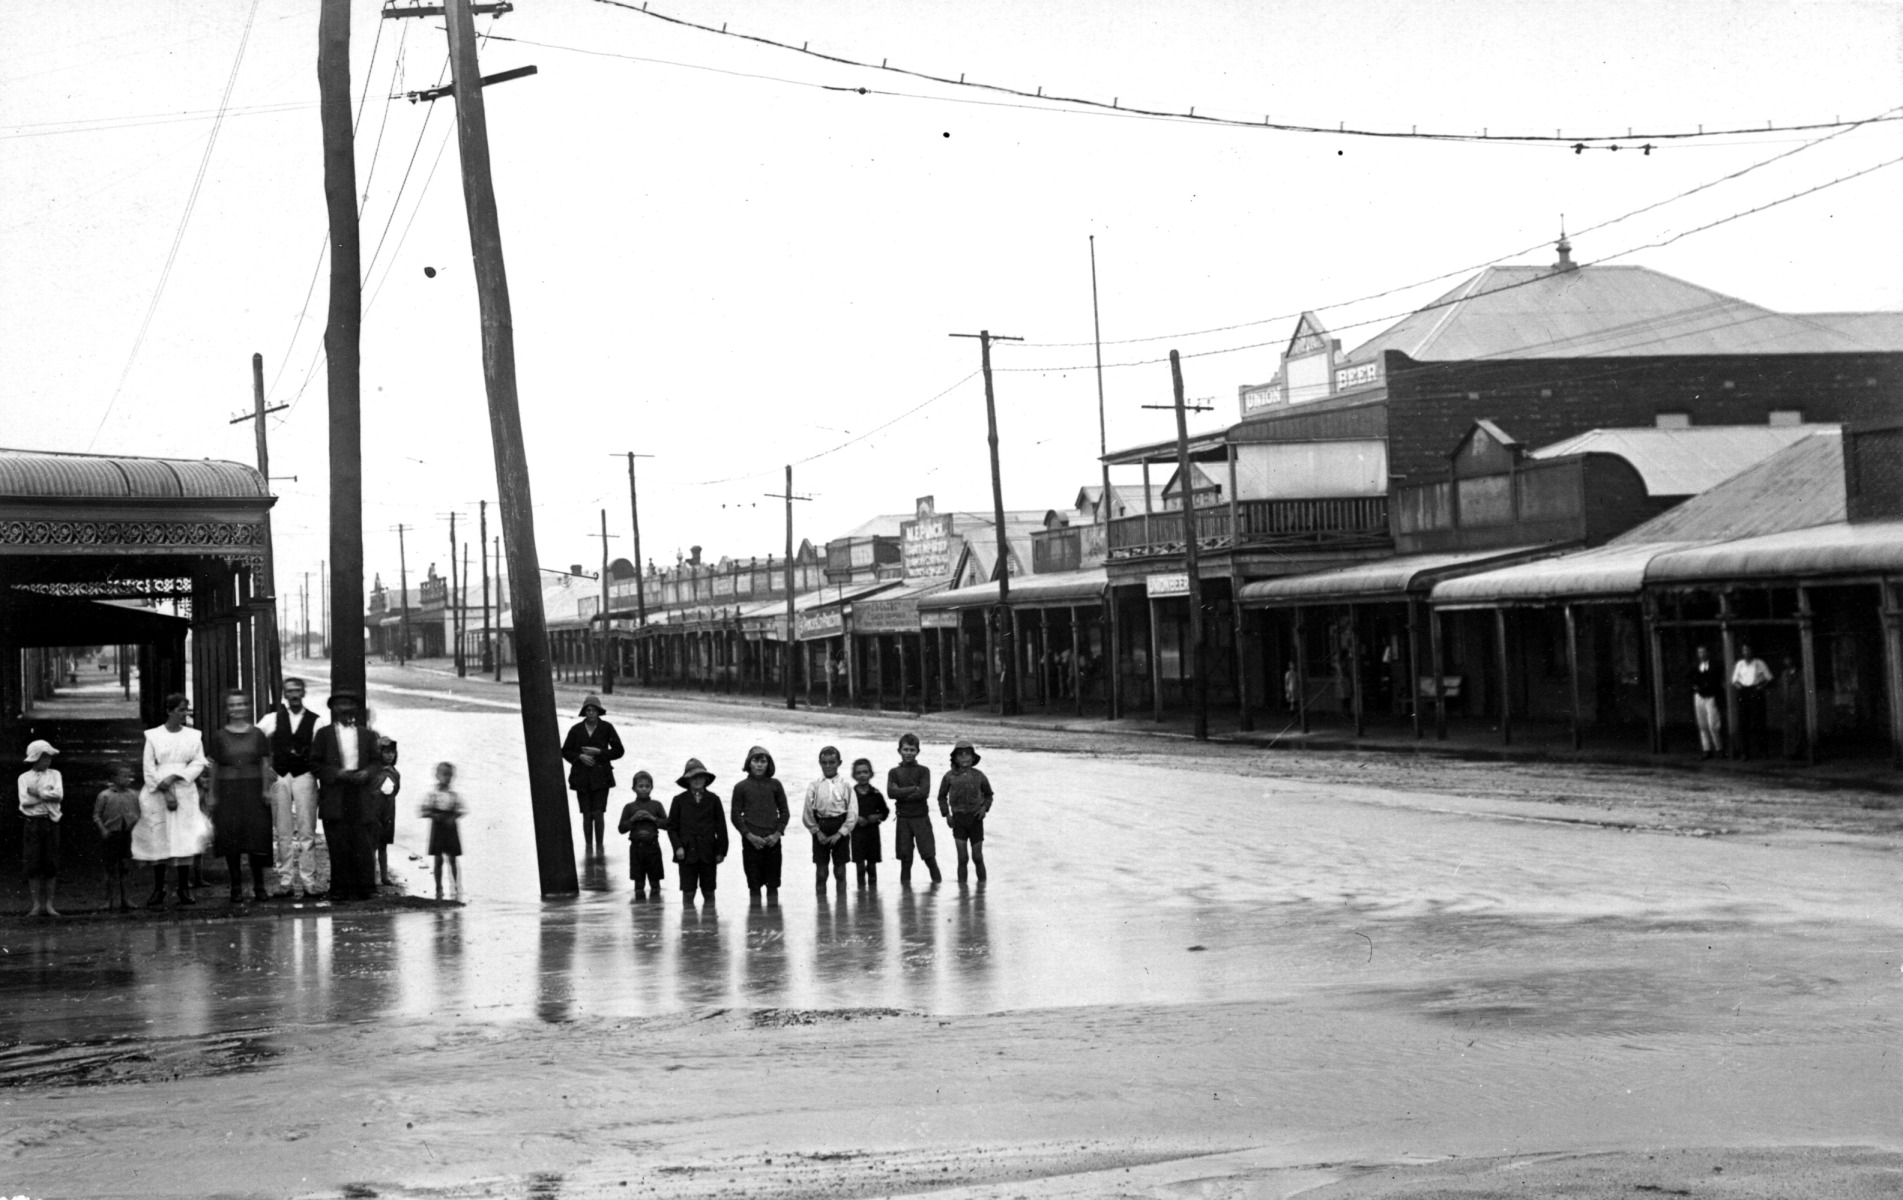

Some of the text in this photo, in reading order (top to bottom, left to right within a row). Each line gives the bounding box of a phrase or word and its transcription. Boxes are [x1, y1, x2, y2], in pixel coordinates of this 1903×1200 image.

[1246, 363, 1378, 410] UNION BEER
[1148, 577, 1170, 593] UNION
